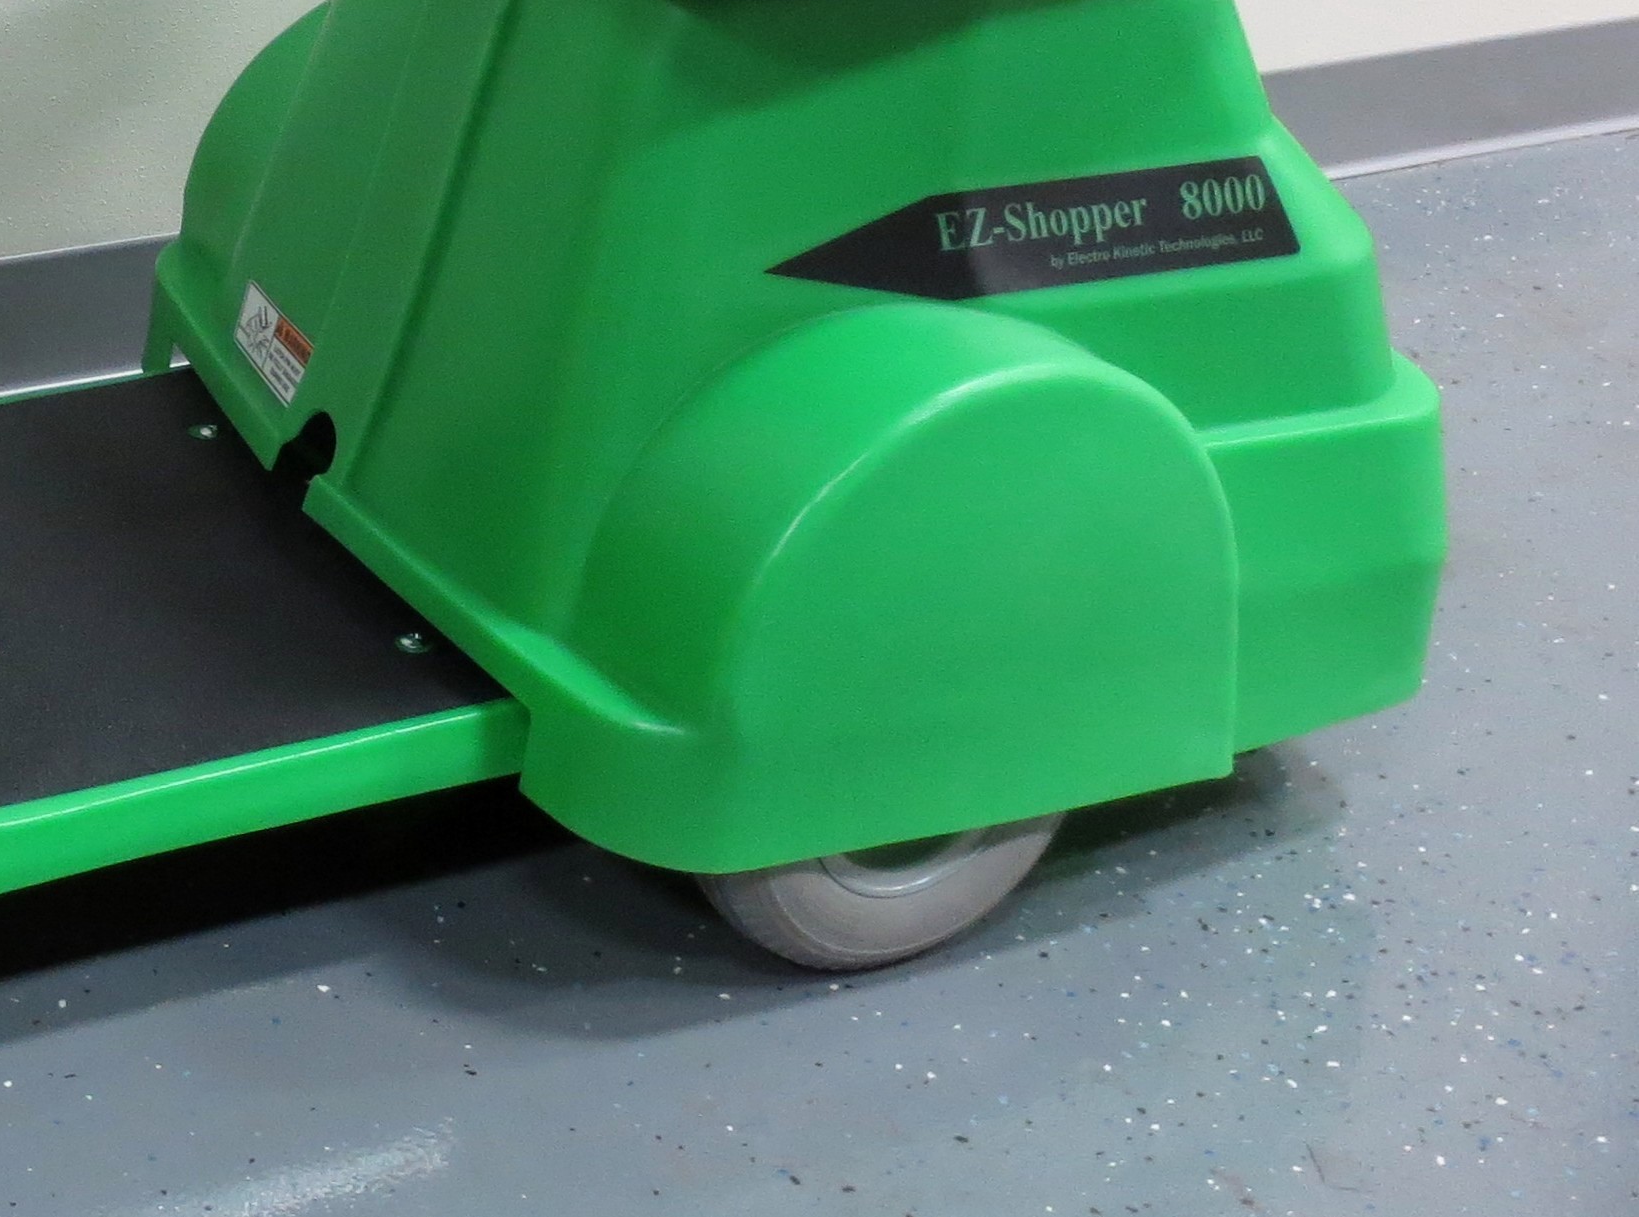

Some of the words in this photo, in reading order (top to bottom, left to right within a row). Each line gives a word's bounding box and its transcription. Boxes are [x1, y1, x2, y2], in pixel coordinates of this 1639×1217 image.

[936, 196, 1147, 252] EZ-Shopper
[1179, 174, 1266, 221] 8000
[1050, 254, 1064, 269] by
[1068, 249, 1110, 265] Electro
[1113, 243, 1155, 259] Kinetic
[1241, 228, 1264, 243] LLC
